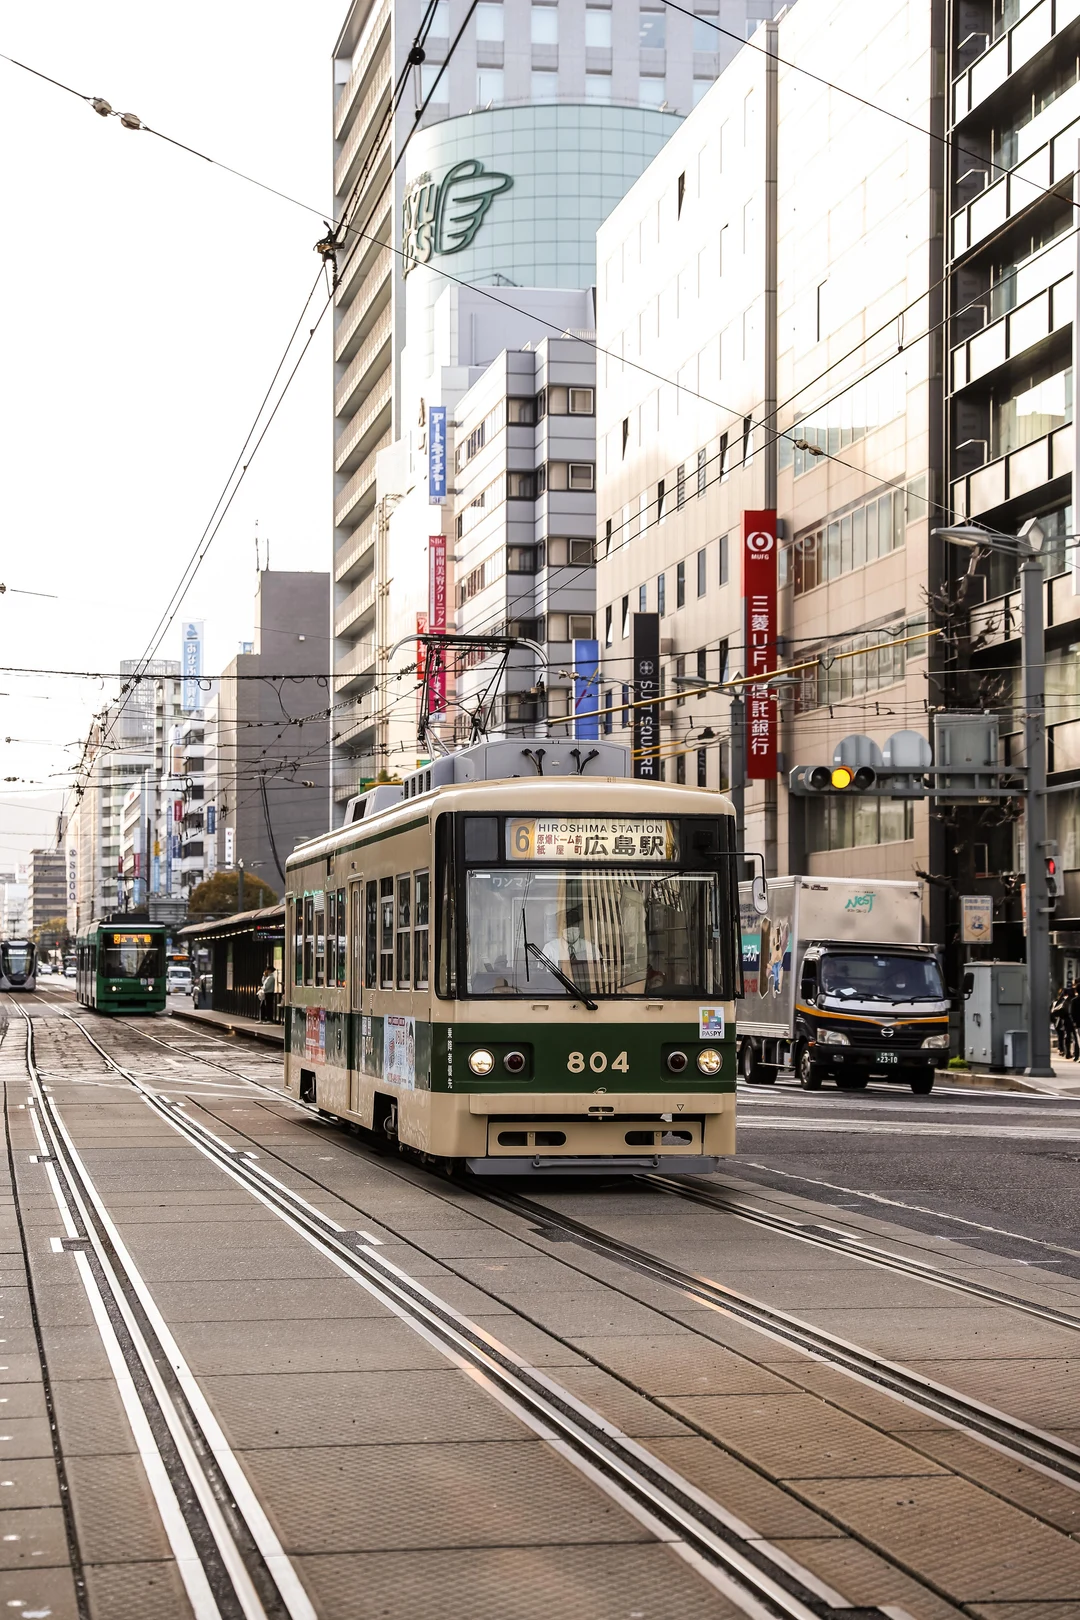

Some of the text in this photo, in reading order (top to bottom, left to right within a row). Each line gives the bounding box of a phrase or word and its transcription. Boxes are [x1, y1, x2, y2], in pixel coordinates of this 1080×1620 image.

[431, 412, 444, 491] アートネイチャー
[435, 547, 445, 626] 湘南美容クリニック
[640, 680, 653, 712] SUT
[515, 825, 530, 852] 6
[536, 834, 583, 845] 原爆ドーム前
[538, 824, 663, 834] HIROSHIMA STATION
[583, 835, 664, 856] 広島駅
[492, 877, 534, 888] ワンマン
[567, 1051, 630, 1073] 804
